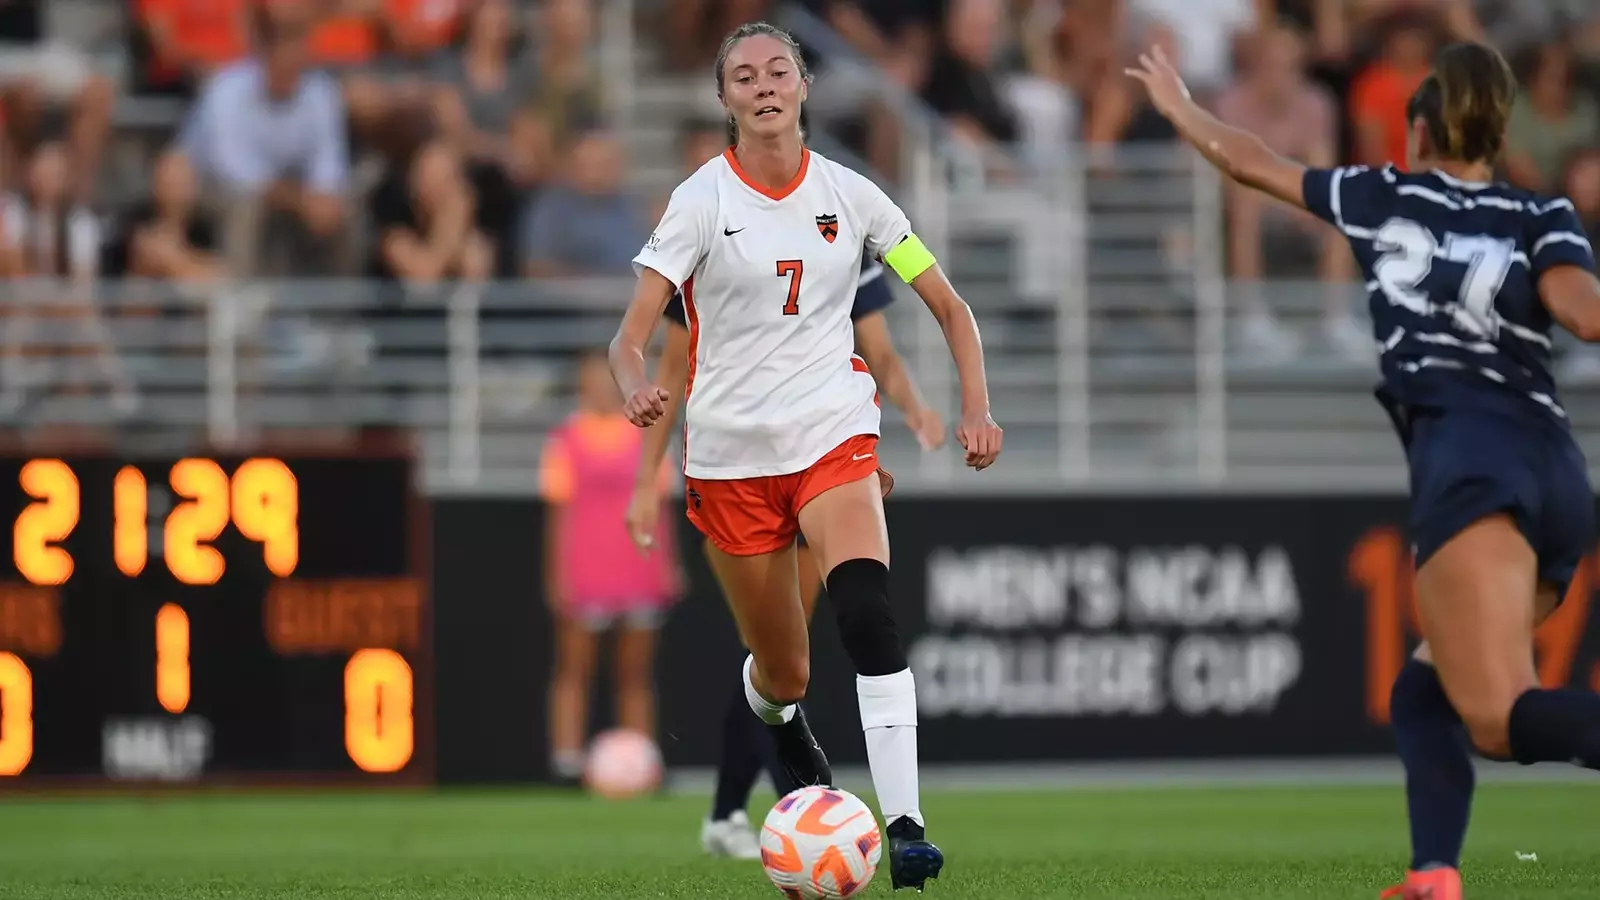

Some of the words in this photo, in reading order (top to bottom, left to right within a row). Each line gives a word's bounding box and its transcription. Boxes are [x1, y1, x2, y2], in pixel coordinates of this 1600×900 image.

[776, 259, 803, 316] 7
[1373, 217, 1516, 340] 27
[929, 549, 1119, 626] MEN'S
[1126, 549, 1298, 626] NCAA
[156, 604, 190, 712] 1
[910, 635, 1162, 714] COLLEGE
[1171, 635, 1298, 712] CUP
[344, 647, 413, 772] 0
